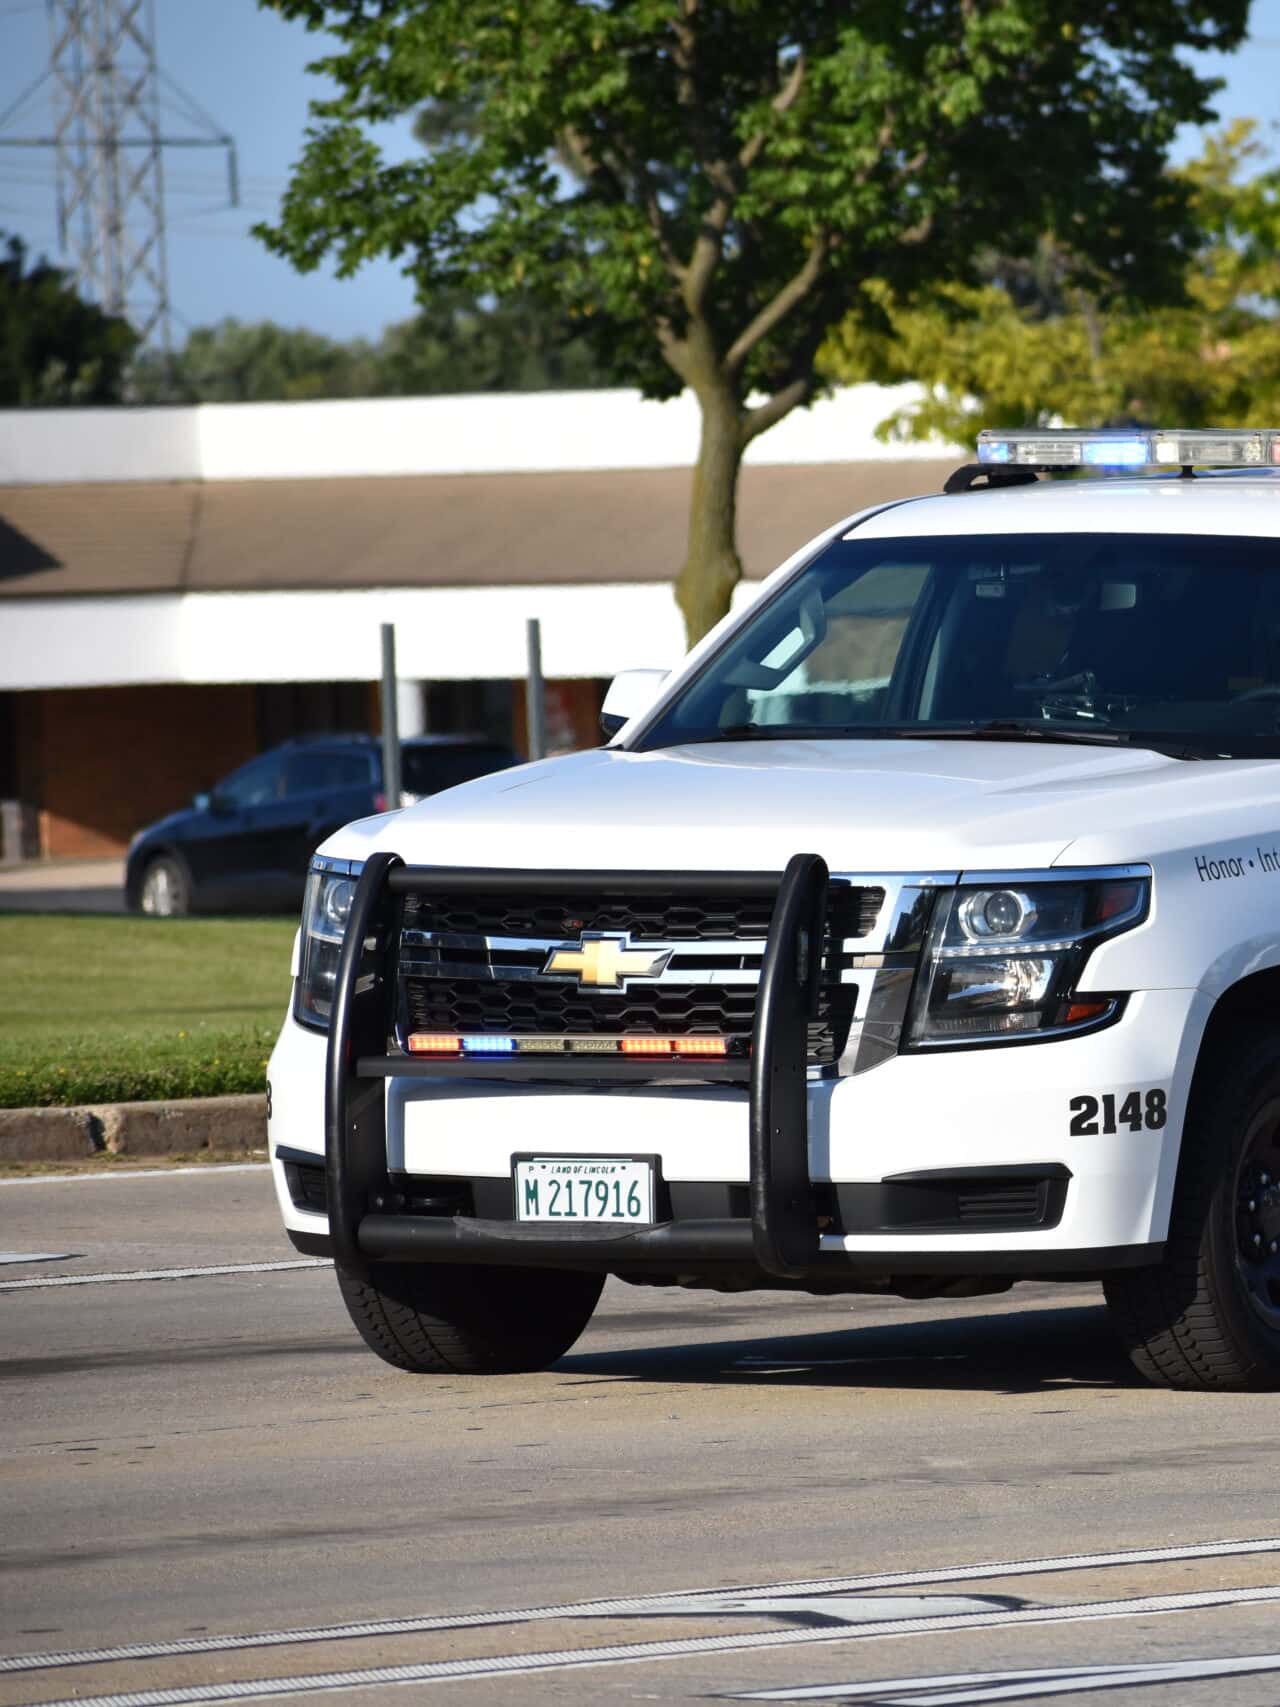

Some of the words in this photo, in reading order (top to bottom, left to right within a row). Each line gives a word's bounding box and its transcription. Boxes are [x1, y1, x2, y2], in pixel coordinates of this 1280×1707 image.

[1194, 855, 1246, 882] Honor
[1069, 1088, 1167, 1136] 2148
[551, 1165, 572, 1174] LAND
[573, 1165, 583, 1174] OF
[583, 1165, 617, 1175] LINCOLN
